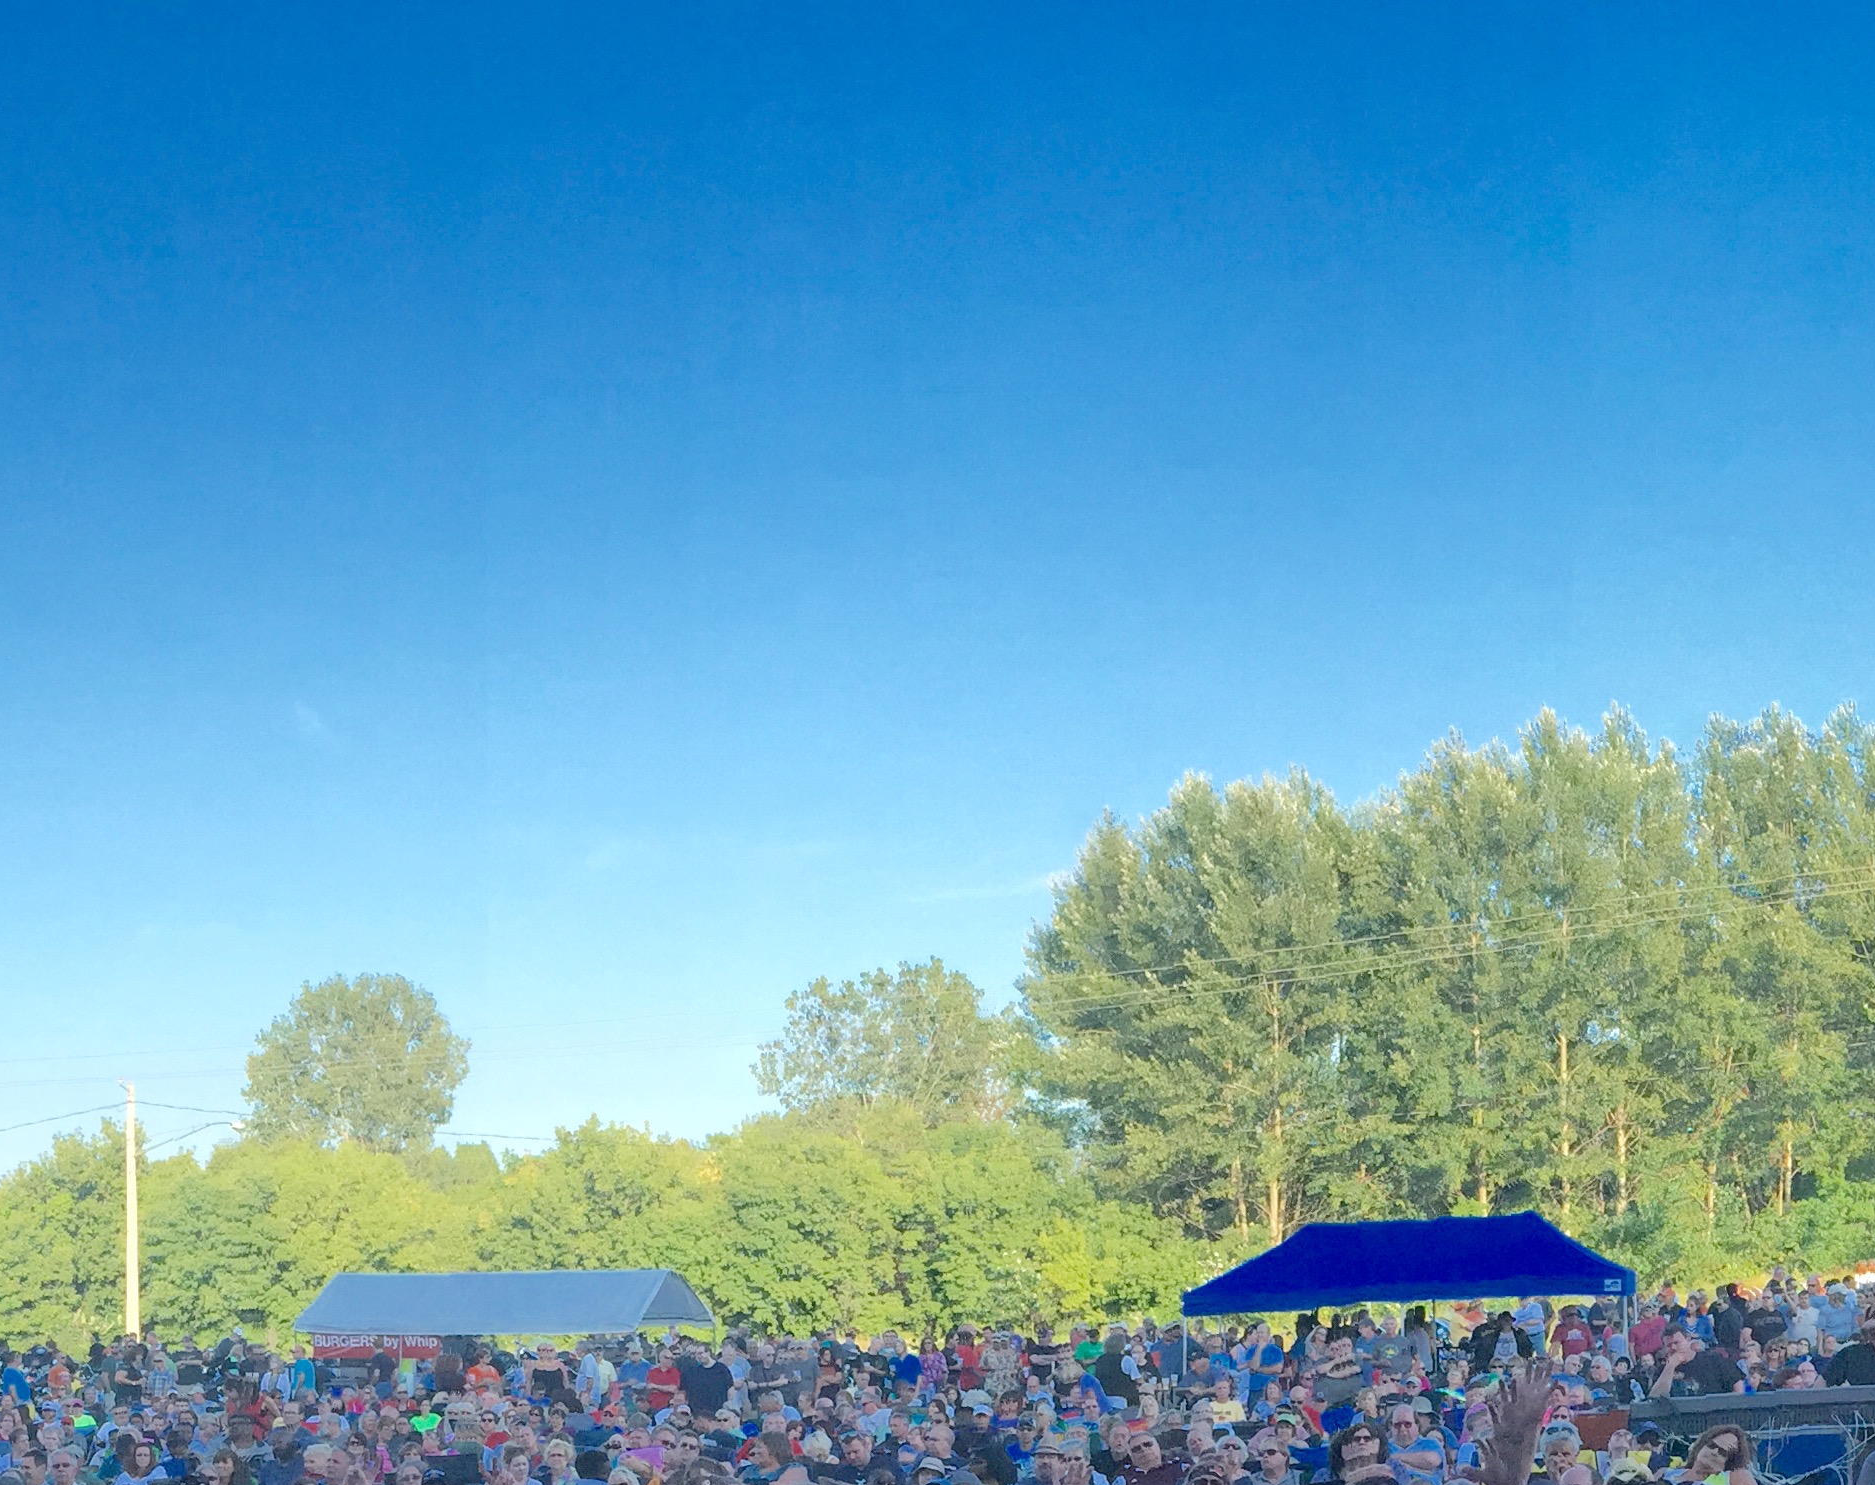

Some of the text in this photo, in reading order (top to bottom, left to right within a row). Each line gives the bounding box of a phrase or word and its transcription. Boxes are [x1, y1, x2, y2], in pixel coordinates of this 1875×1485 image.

[314, 1335, 438, 1349] BURGERS by Whip
